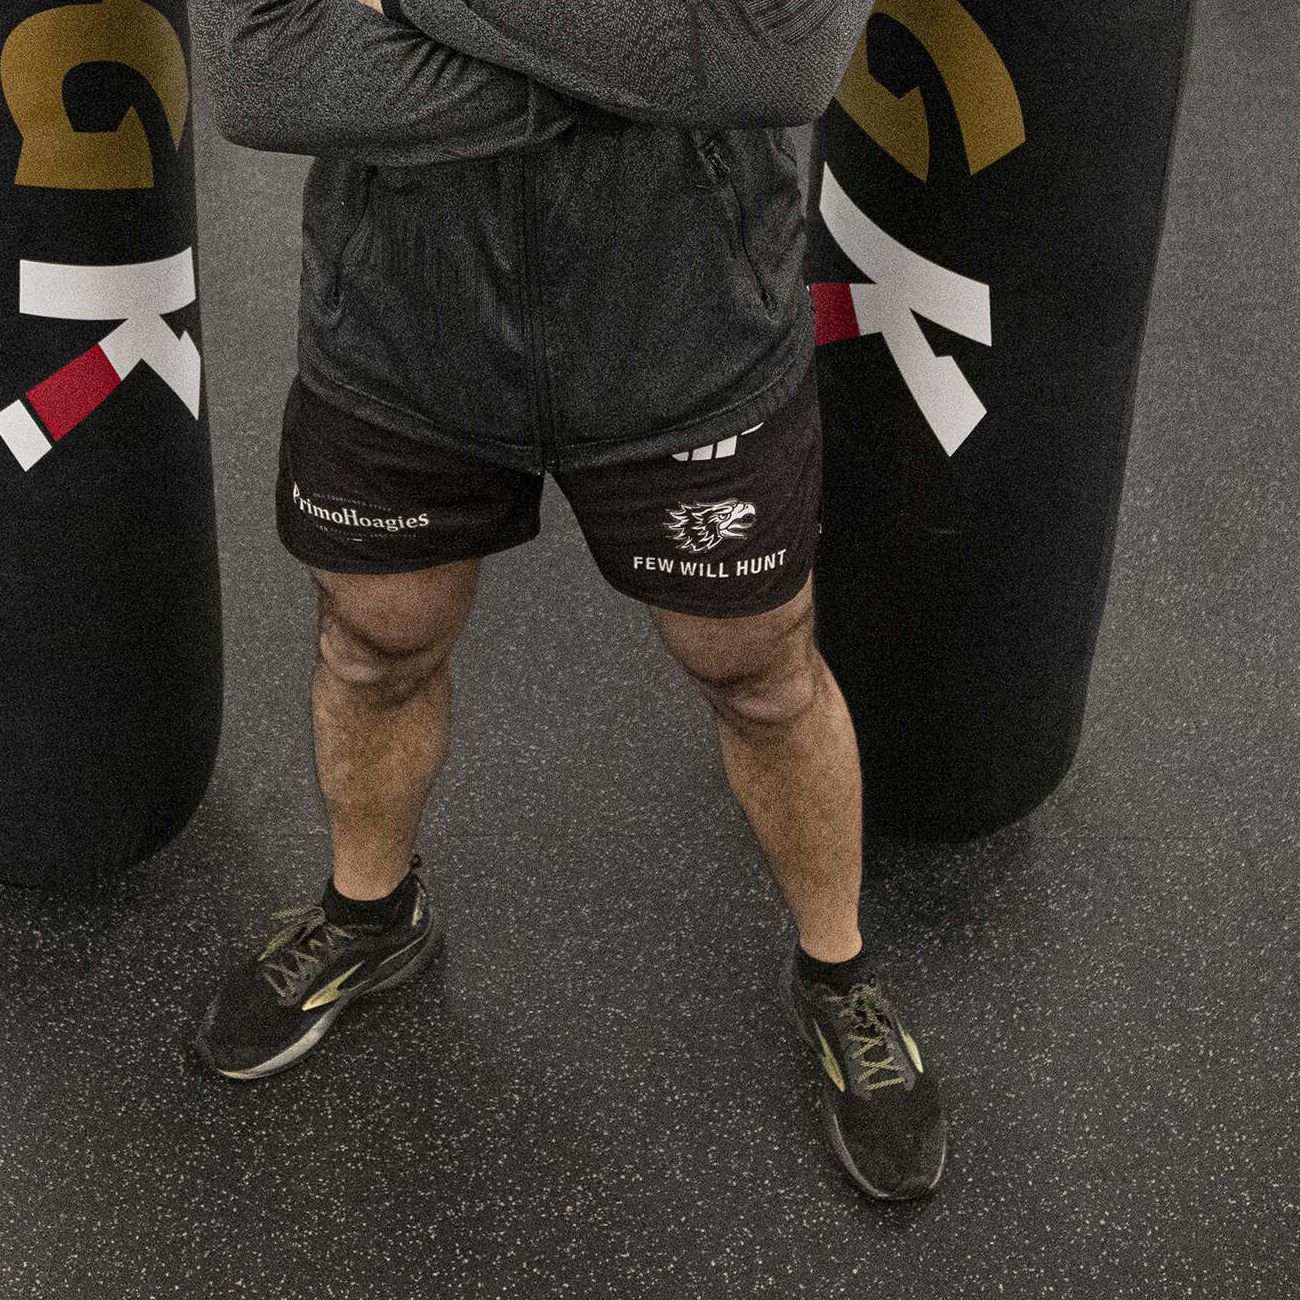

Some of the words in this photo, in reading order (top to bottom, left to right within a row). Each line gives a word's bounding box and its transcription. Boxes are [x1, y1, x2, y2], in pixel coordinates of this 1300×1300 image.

[292, 481, 430, 532] PrimoHoagies
[633, 555, 675, 574] FEW
[679, 560, 730, 579] WILL
[736, 548, 788, 577] HUNT
